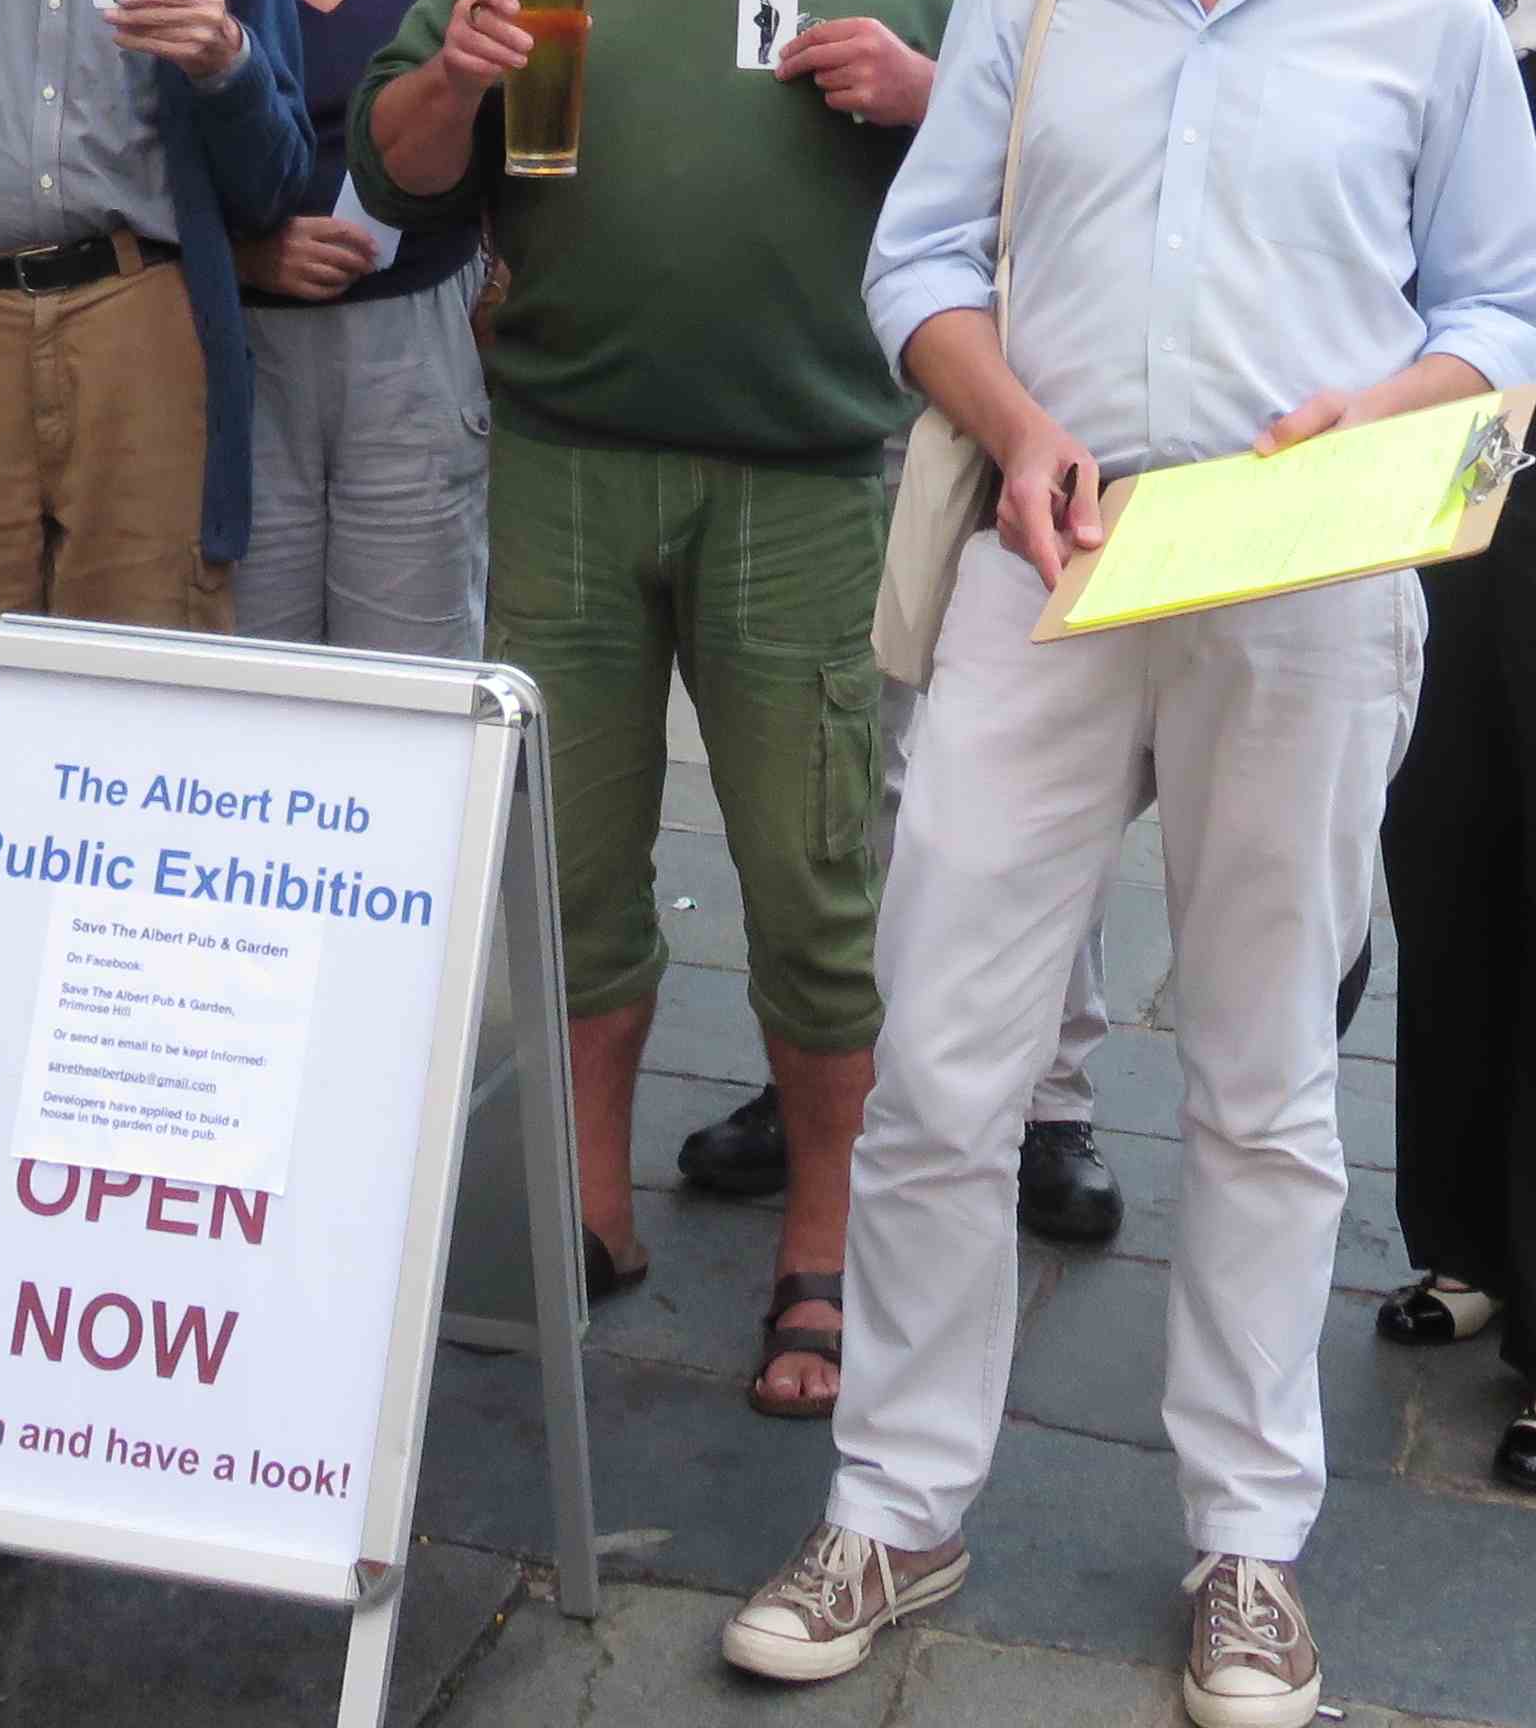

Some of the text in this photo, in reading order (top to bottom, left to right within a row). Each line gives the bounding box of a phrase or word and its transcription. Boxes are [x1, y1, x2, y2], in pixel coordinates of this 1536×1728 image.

[54, 763, 370, 834] The Albert Pub
[153, 848, 434, 927] Exhibition
[66, 951, 82, 964] On
[72, 918, 289, 958] Save The Albert Pub & Garden
[59, 998, 110, 1014] Primrose
[62, 982, 88, 995] Save
[92, 986, 112, 999] The
[116, 989, 149, 1003] Albert
[152, 994, 175, 1007] Pub
[178, 997, 186, 1009] &
[53, 1028, 67, 1040] Or
[70, 1032, 98, 1044] send
[100, 1037, 115, 1047] an
[117, 1039, 148, 1051] email
[151, 1041, 162, 1053] to
[165, 1044, 180, 1056] be
[182, 1046, 209, 1060] kept
[40, 1107, 75, 1120] house
[78, 1110, 88, 1123] in
[91, 1114, 110, 1126] the
[112, 1119, 153, 1131] garden
[155, 1123, 168, 1134] of
[170, 1124, 189, 1138] the
[43, 1090, 240, 1128] Developers have applied to build a
[16, 1157, 270, 1246] OPEN
[10, 1280, 240, 1385] NOW
[18, 1424, 94, 1459] and
[105, 1428, 200, 1475] have
[212, 1452, 236, 1482] a
[249, 1450, 352, 1500] look!
